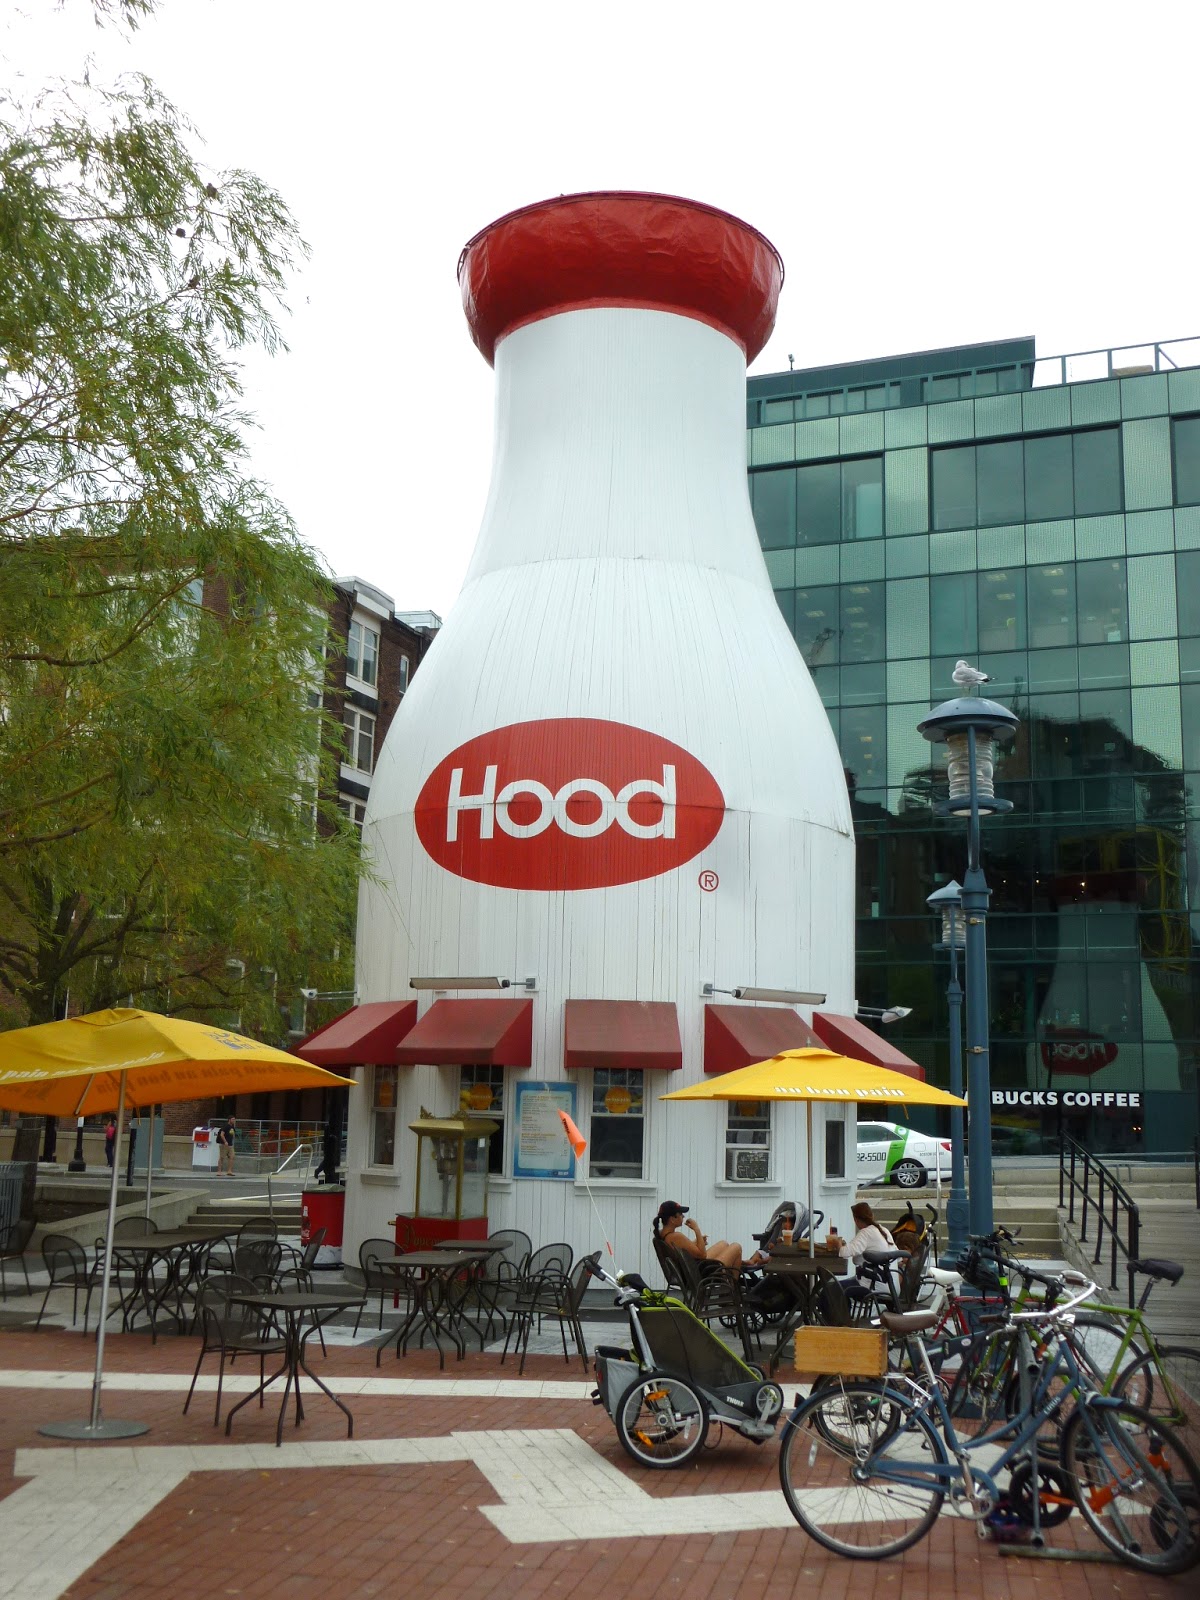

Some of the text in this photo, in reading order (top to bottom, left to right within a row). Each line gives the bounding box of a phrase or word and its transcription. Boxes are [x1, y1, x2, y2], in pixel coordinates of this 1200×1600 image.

[446, 763, 676, 842] Hood
[805, 1086, 851, 1096] bon
[854, 1086, 906, 1097] pain
[1062, 1091, 1140, 1108] COFFEE
